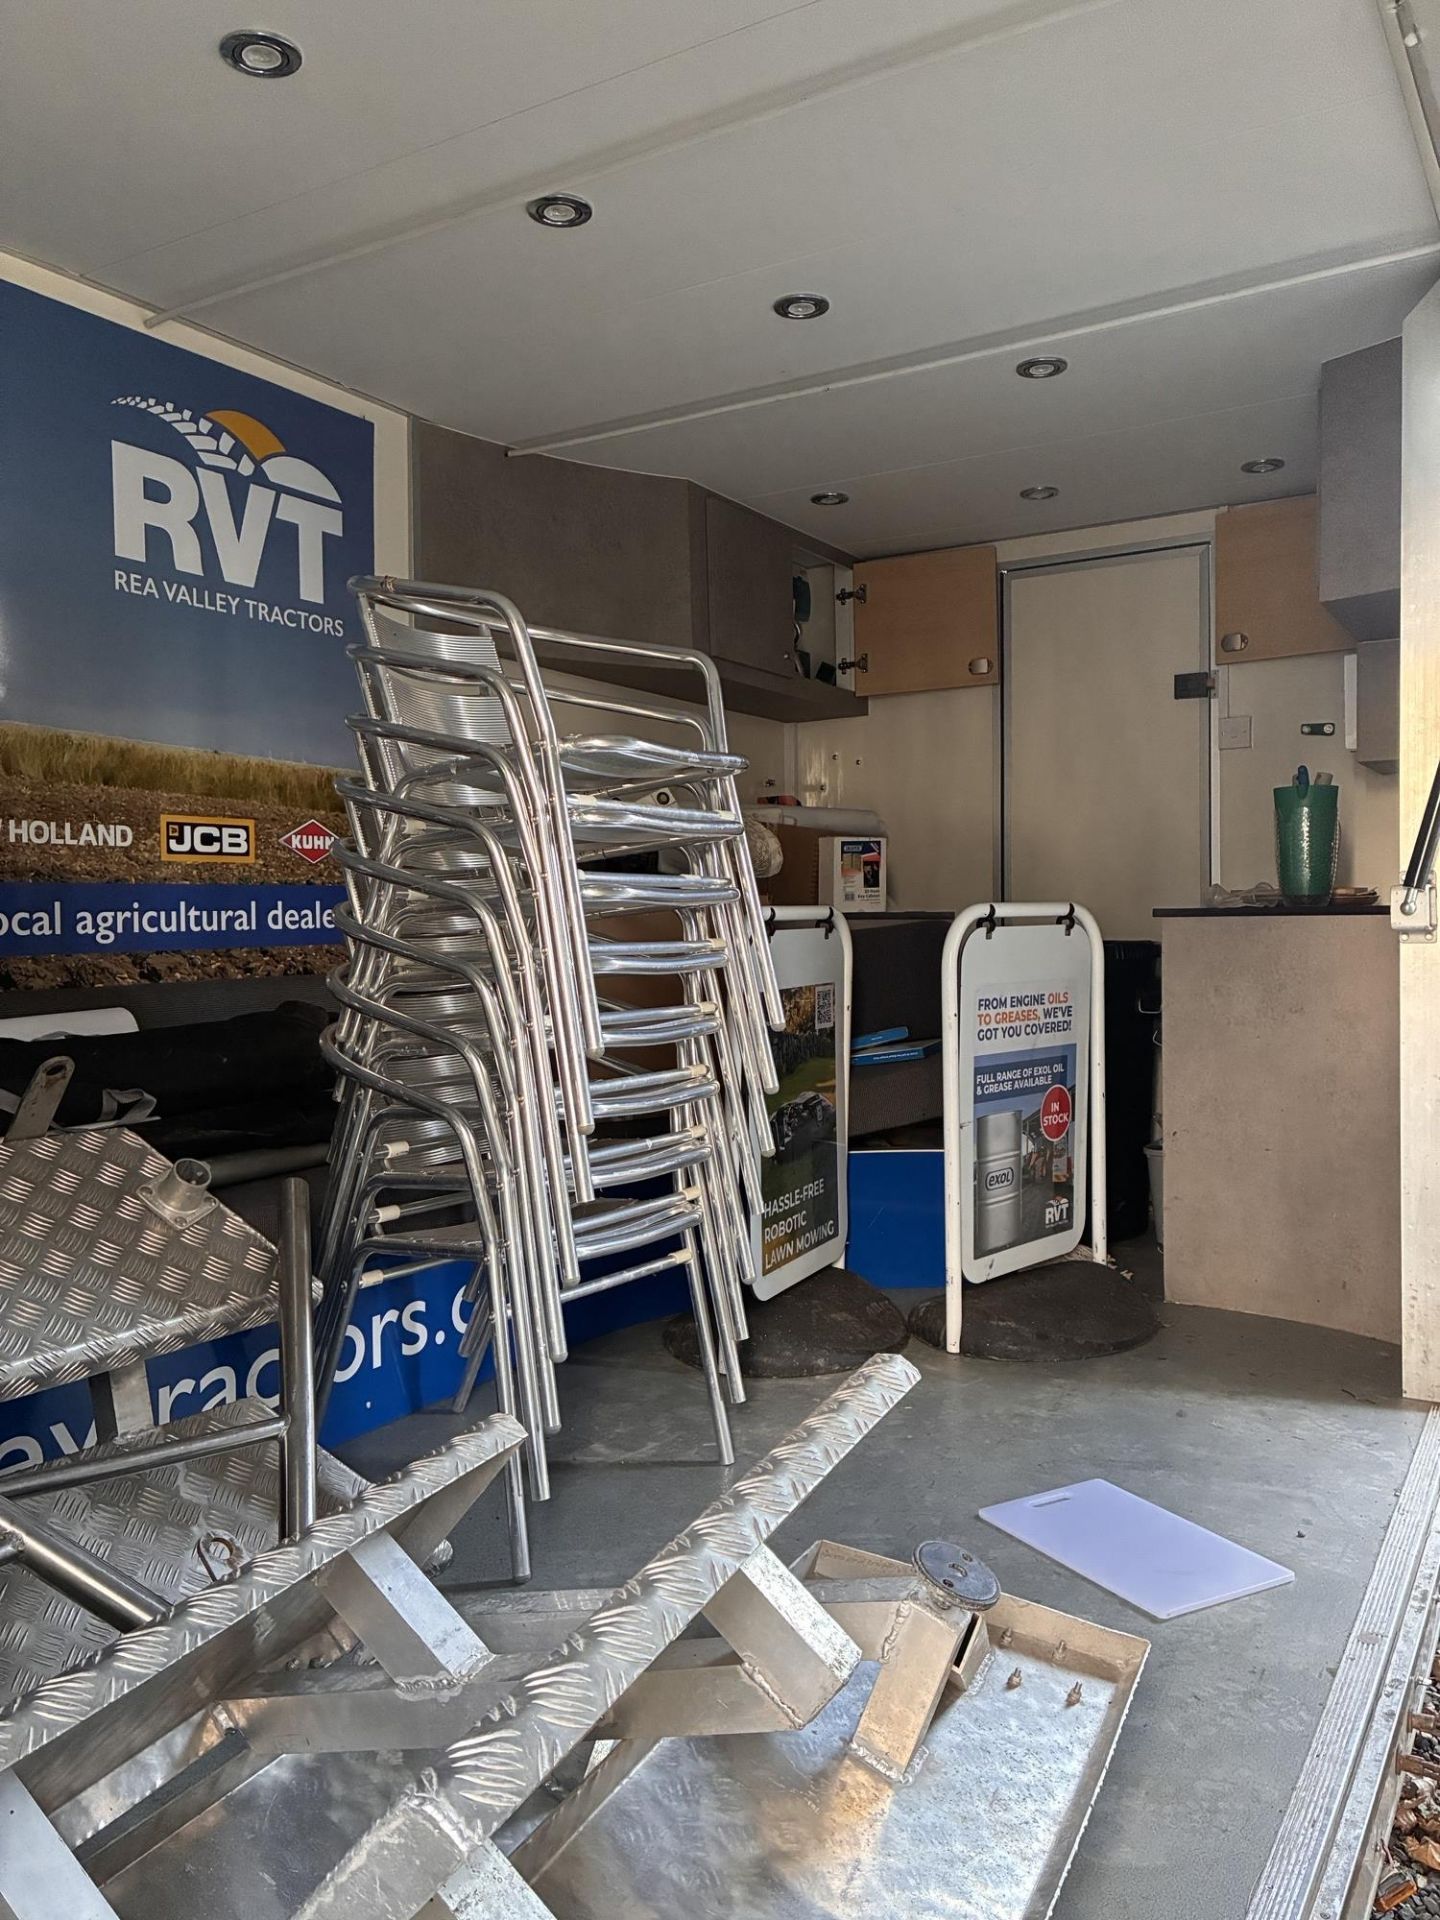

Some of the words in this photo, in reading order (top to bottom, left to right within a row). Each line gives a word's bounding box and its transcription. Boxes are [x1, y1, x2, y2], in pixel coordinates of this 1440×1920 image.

[111, 439, 343, 604] RVT
[114, 569, 159, 599] REA
[162, 580, 240, 616] VALLEY
[244, 598, 345, 638] TRACTORS
[8, 819, 133, 847] HOLLAND
[168, 825, 250, 855] JCB
[75, 900, 257, 945] agricultural
[978, 997, 1008, 1011] FROM
[1010, 993, 1046, 1009] ENGINE
[1047, 991, 1069, 1005] OILS
[977, 1013, 992, 1027] TO
[994, 1009, 1041, 1024] GREASES,
[1043, 1006, 1073, 1020] WE'VE
[977, 1027, 999, 1042] GOT
[1001, 1025, 1022, 1041] YOU
[1024, 1020, 1072, 1037] COVERED!
[976, 1073, 995, 1085] FULL
[996, 1069, 1021, 1082] RANGE
[1022, 1067, 1033, 1077] OF
[1033, 1065, 1052, 1076] EXOL
[1053, 1063, 1065, 1073] OIL
[976, 1086, 982, 1096] &
[983, 1082, 1013, 1095] GREASE
[1013, 1075, 1052, 1090] AVAILABLE
[1043, 1113, 1069, 1127] STOCK
[1050, 1101, 1060, 1113] IN
[764, 1177, 825, 1219] HASSLE-FREE
[764, 1210, 807, 1244] ROBOTIC
[765, 1240, 794, 1270] LAWN
[796, 1219, 834, 1254] MOWING
